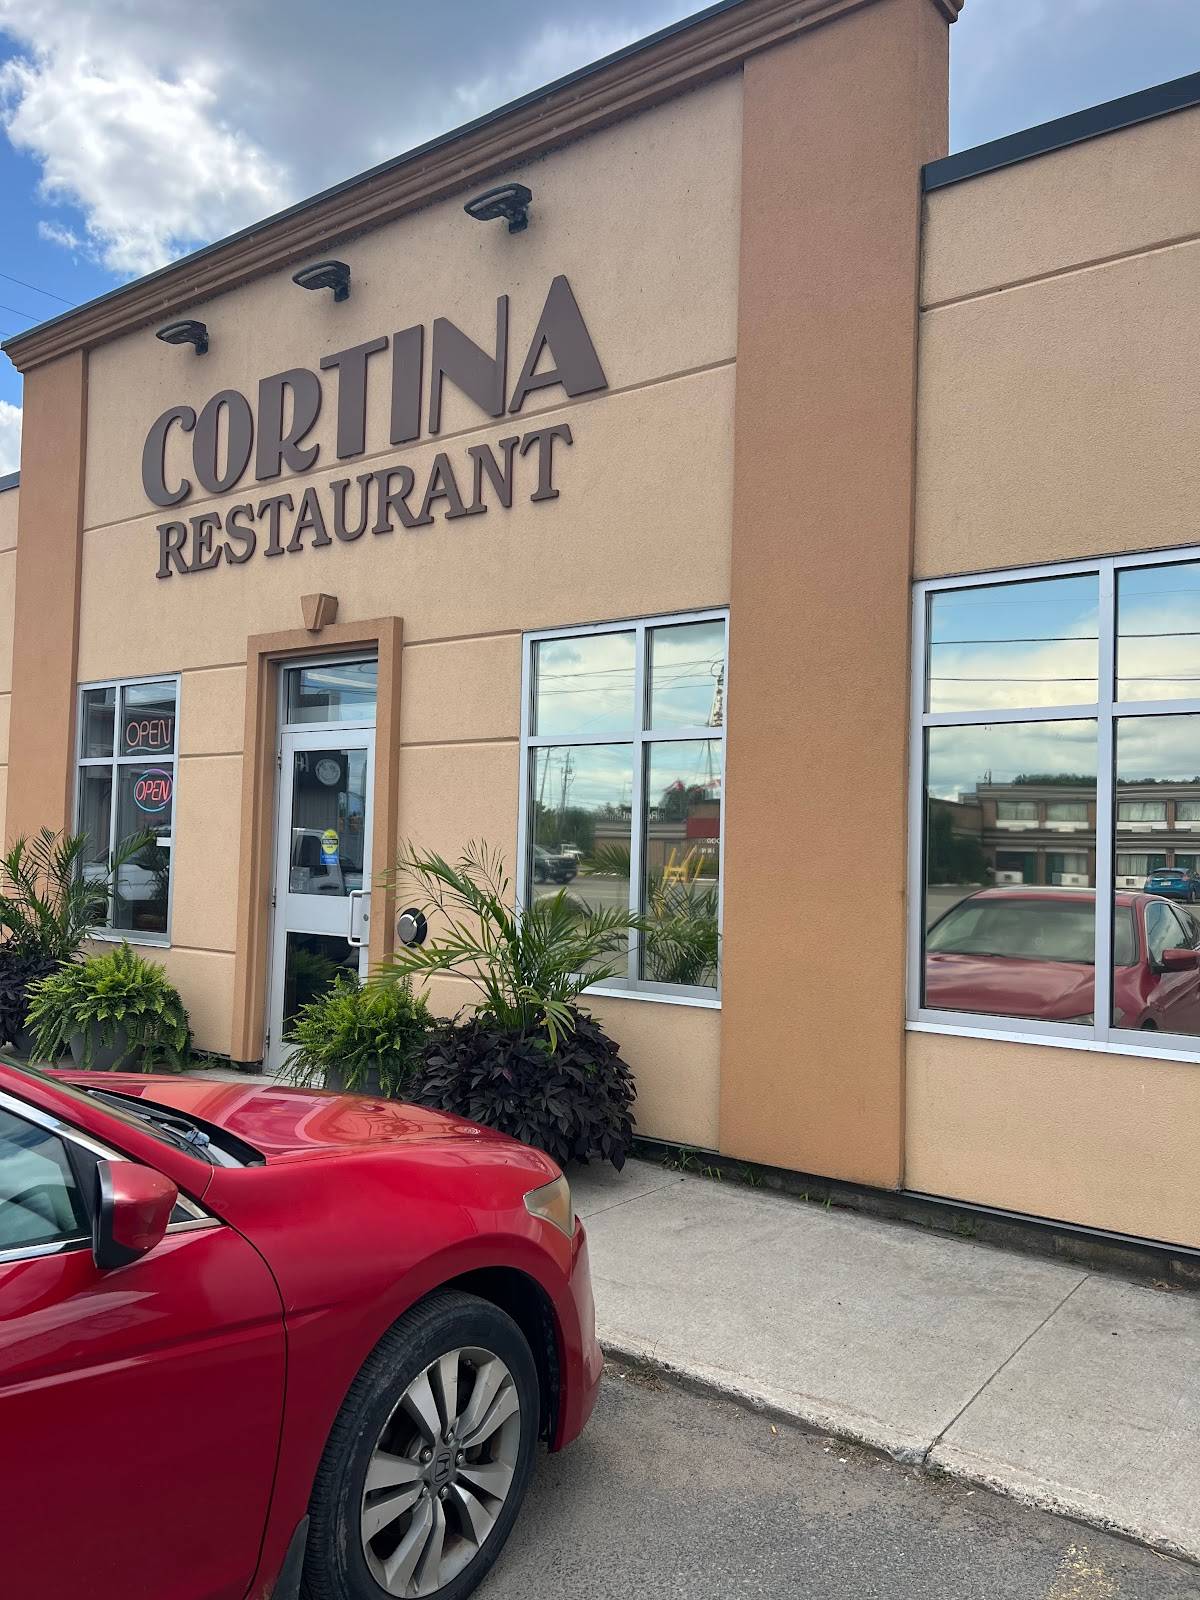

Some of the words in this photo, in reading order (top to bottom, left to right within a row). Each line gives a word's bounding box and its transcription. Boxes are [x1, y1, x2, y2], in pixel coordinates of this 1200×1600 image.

[142, 274, 608, 507] CORTINA
[156, 423, 573, 579] RESTAURANT
[126, 719, 171, 746] OPEN
[135, 780, 170, 800] OPEN
